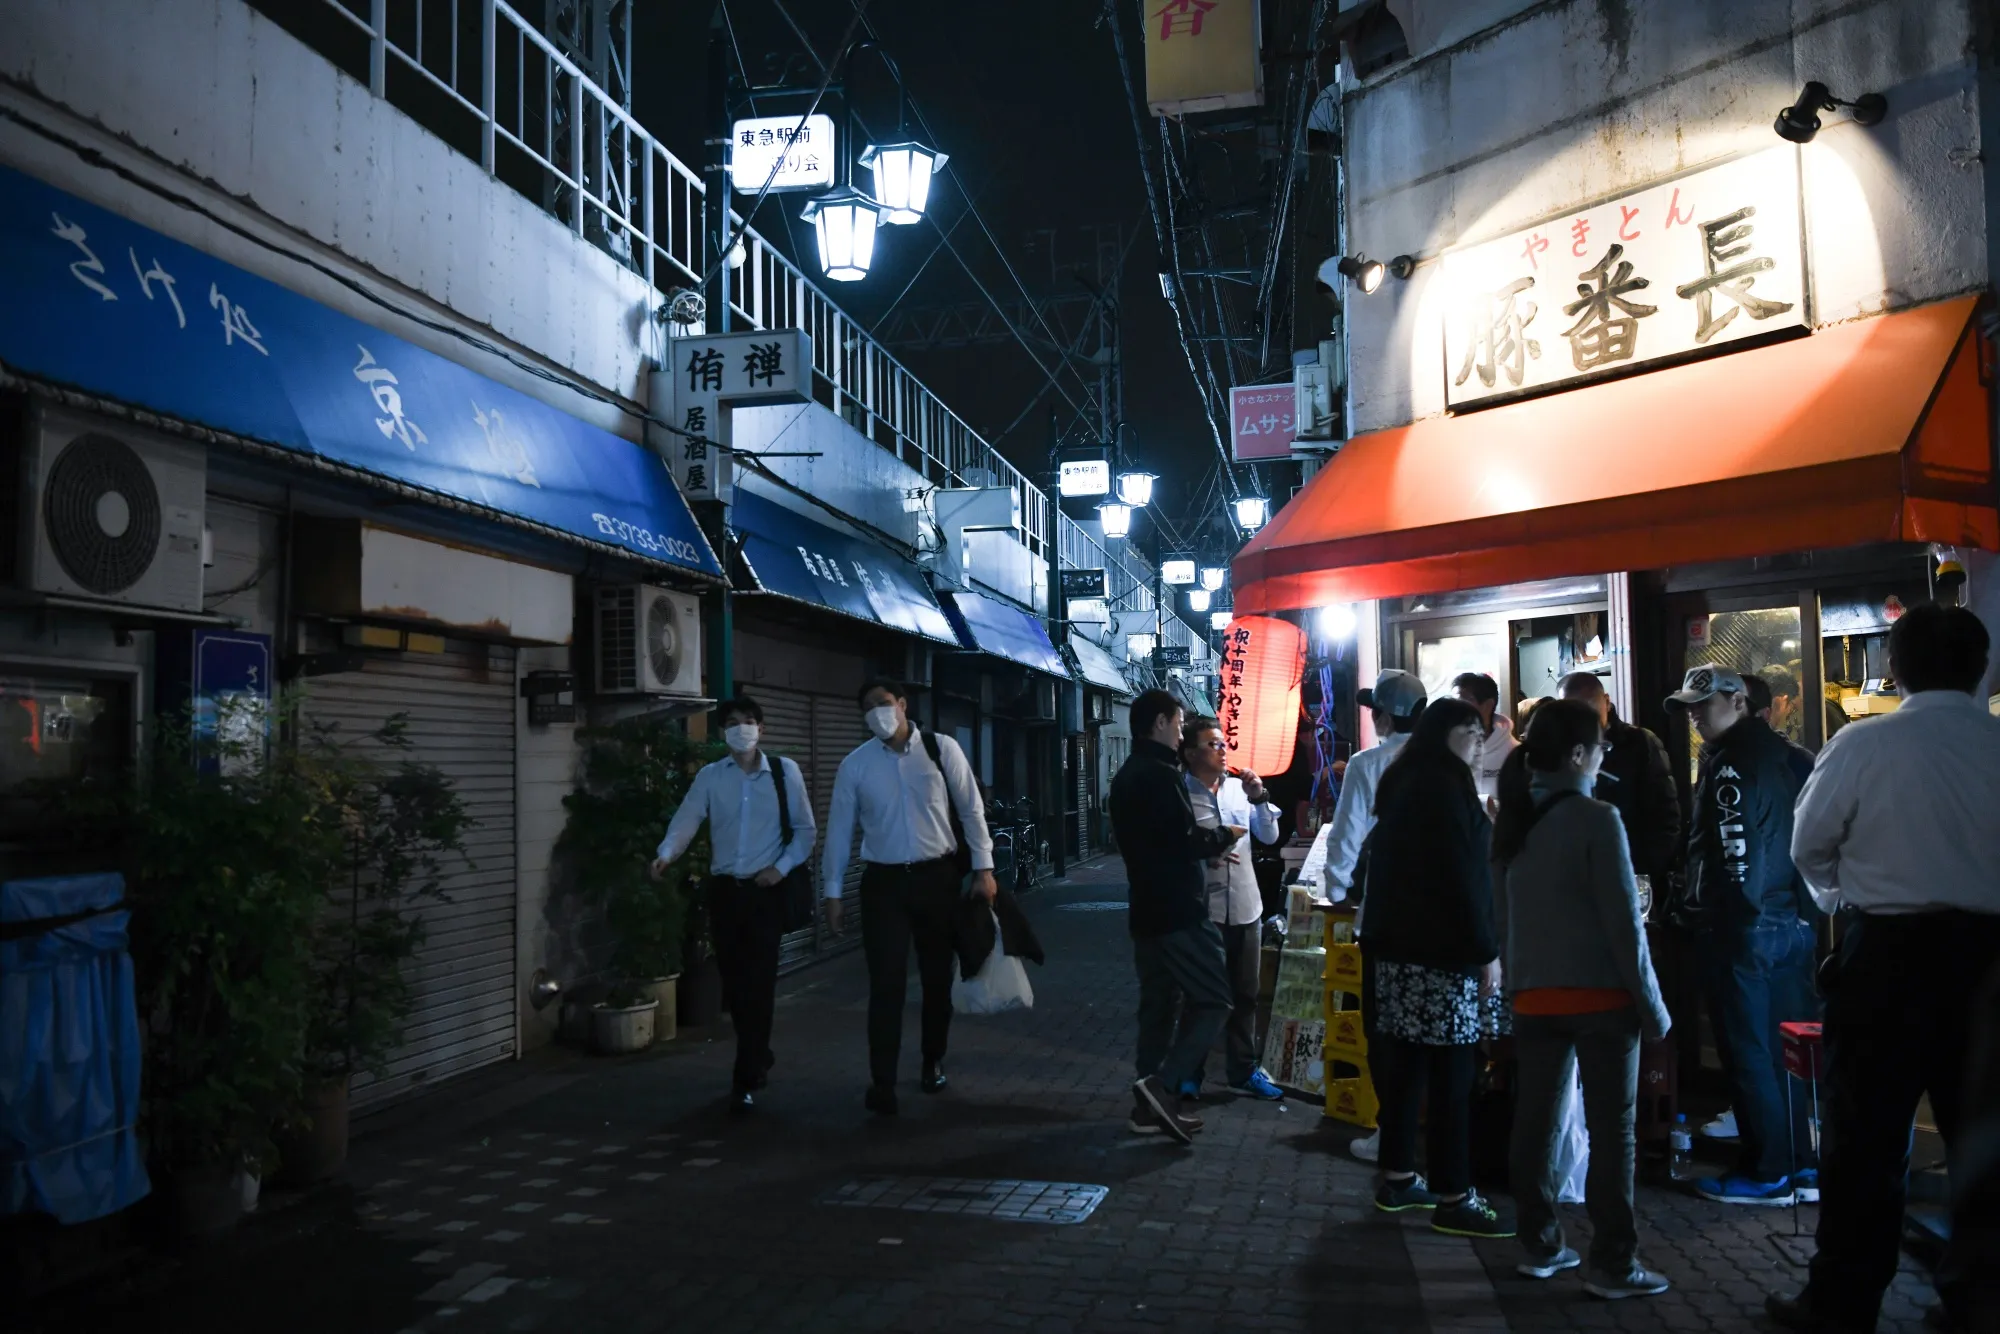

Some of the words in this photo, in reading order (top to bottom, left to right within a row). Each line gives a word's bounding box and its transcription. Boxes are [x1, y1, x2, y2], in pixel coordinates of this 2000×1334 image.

[740, 126, 811, 147] 東急駅前
[1521, 188, 1695, 270] やきとん
[1455, 205, 1794, 388] 豚番長
[685, 341, 786, 392] 侑禅
[1238, 392, 1296, 405] 小さなスナック
[1239, 413, 1296, 435] ムサシ
[684, 406, 708, 491] 居酒屋
[612, 517, 700, 564] 3733-0023
[1229, 628, 1250, 689] 祝十周年
[1225, 693, 1242, 751] やきとん
